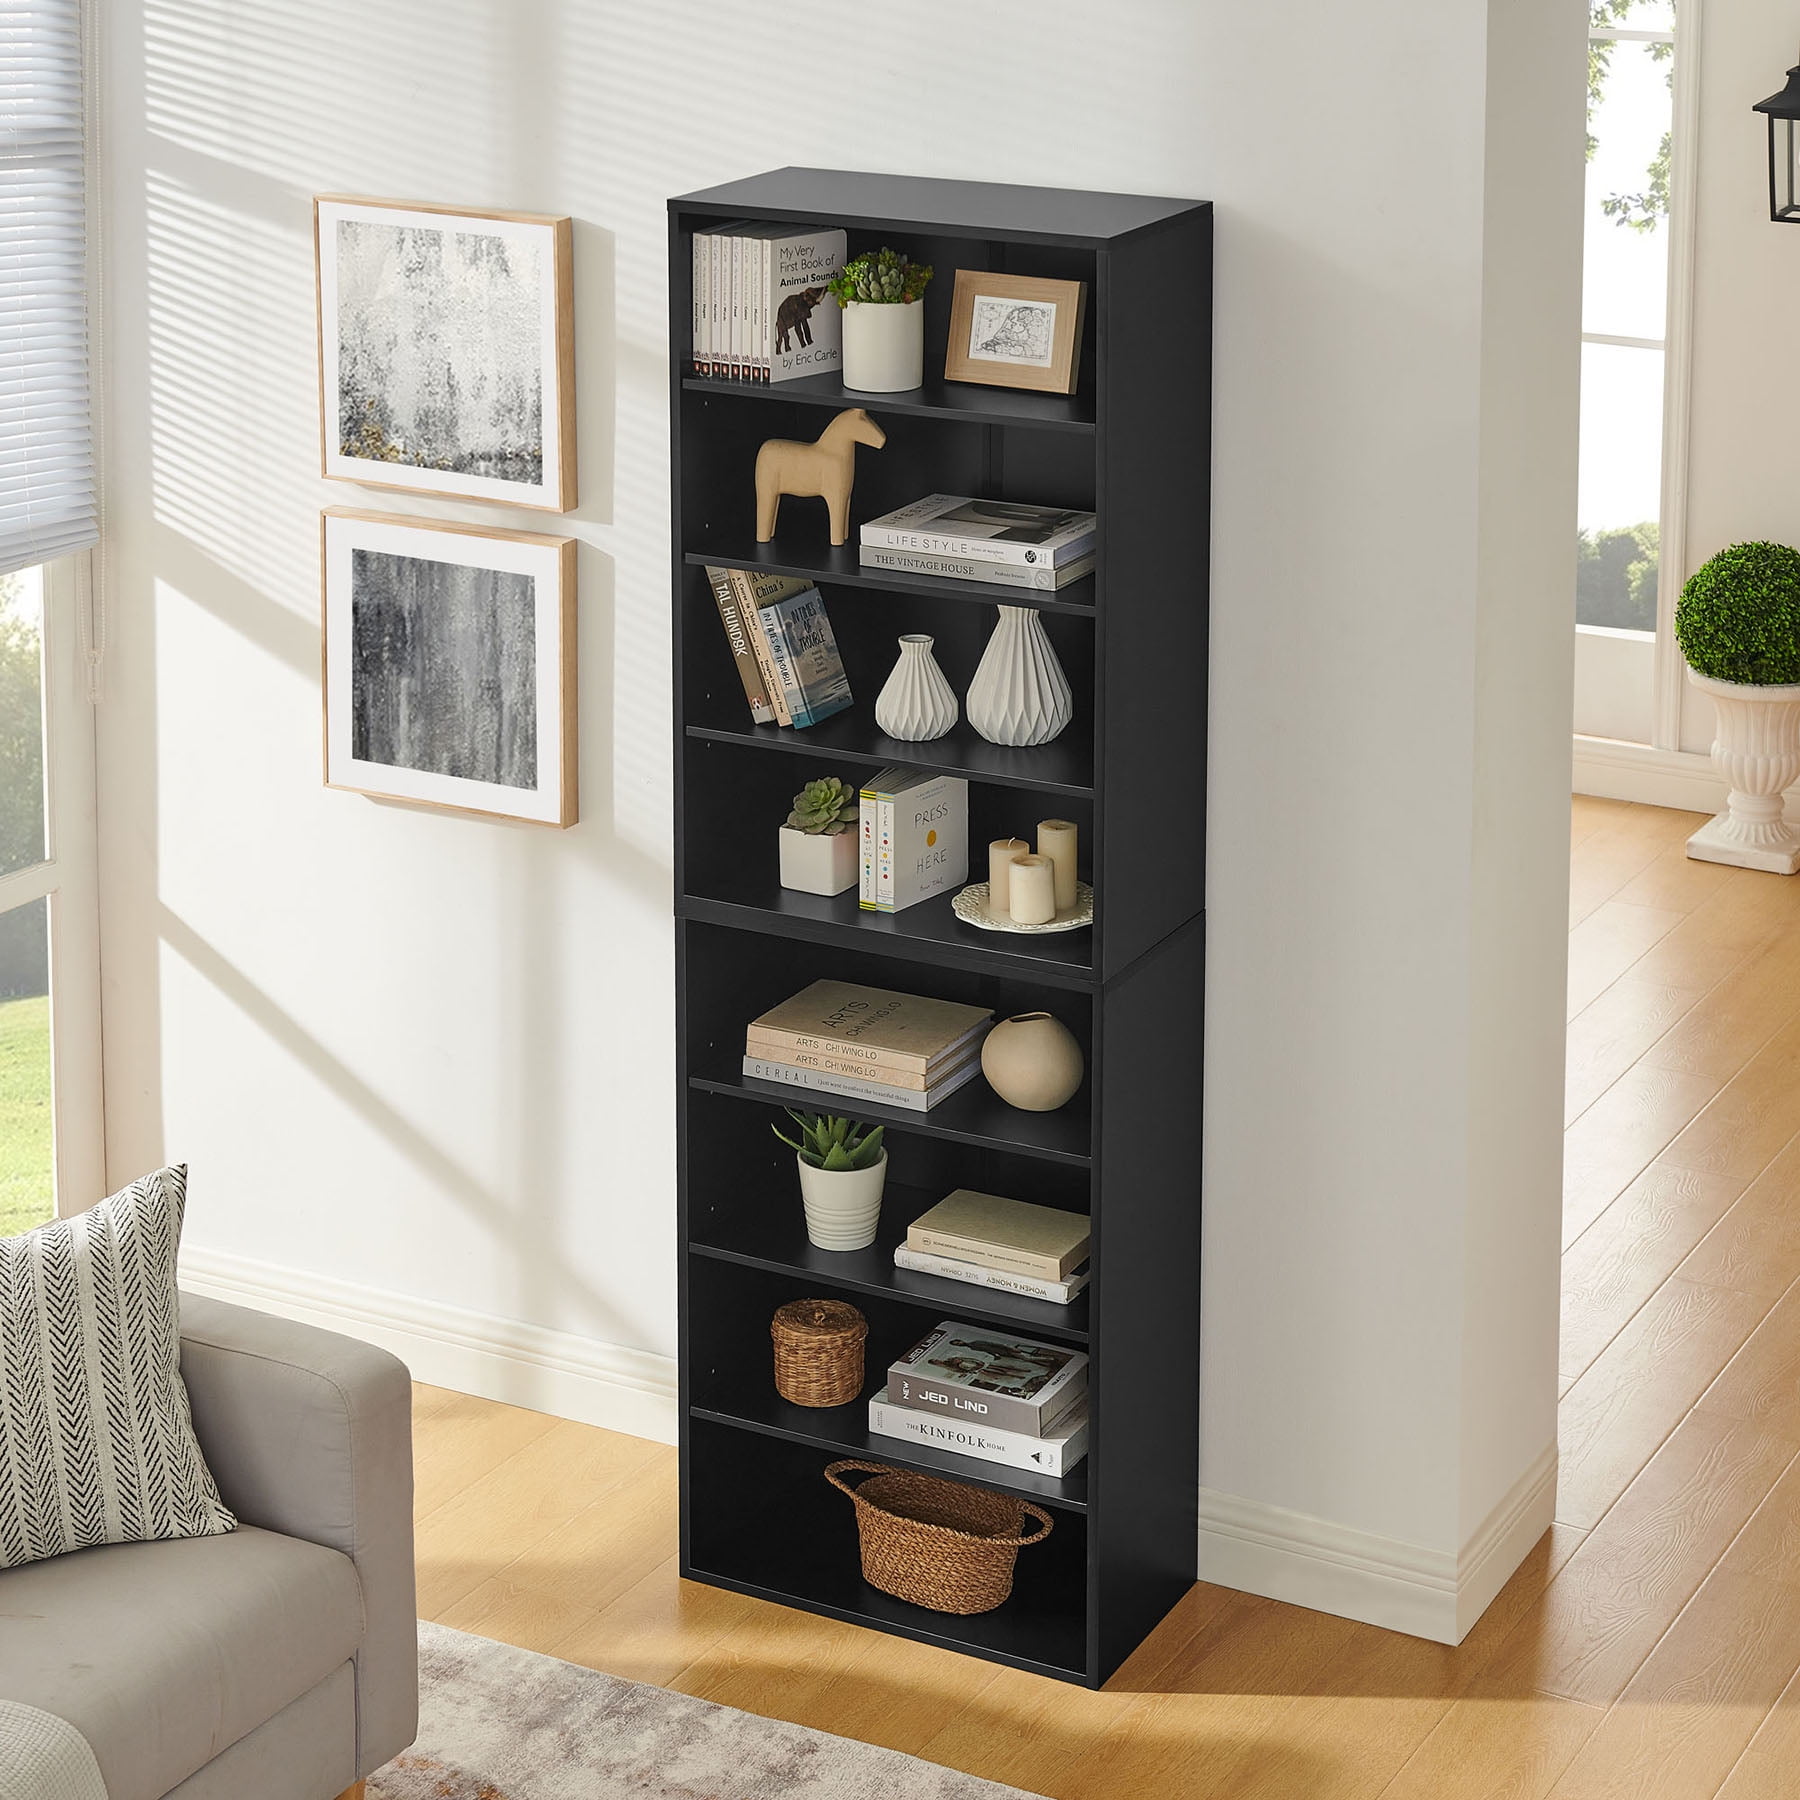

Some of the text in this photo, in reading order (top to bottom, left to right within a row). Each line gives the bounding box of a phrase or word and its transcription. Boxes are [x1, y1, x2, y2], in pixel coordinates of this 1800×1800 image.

[780, 245, 815, 260] My Very
[780, 253, 836, 273] First Book of
[780, 270, 840, 288] Animal Sounds
[783, 349, 838, 369] by Eric Carle
[887, 534, 918, 547] LIFE
[922, 539, 968, 554] STYLE
[875, 554, 975, 576] THE VINTAGE HOUSE
[715, 583, 732, 604] TAL
[756, 580, 784, 599] China's
[798, 602, 817, 622] TIMES
[722, 605, 748, 657] HUNDSK
[803, 620, 812, 634] OF
[763, 612, 793, 688] IN TIMES OF TROUBLE
[799, 628, 826, 653] TROUBLE
[914, 802, 949, 828] PRESS
[916, 848, 947, 875] HERE
[821, 1000, 870, 1028] ARTS
[846, 1001, 905, 1038] CHI WING LO
[796, 1038, 878, 1060] ARTS CHI WING LO
[755, 1064, 809, 1084] CEREAL
[795, 1054, 877, 1078] ARTS CHI WING LO
[940, 1266, 979, 1280] SUZE ORMAN
[986, 1276, 1012, 1288] MONEY
[1019, 1284, 1047, 1296] WOMEN
[908, 1332, 942, 1363] JED LIND
[902, 1380, 910, 1400] NEW
[918, 1390, 988, 1415] JED LIND
[906, 1422, 1006, 1452] THE KINFOLK HOME
